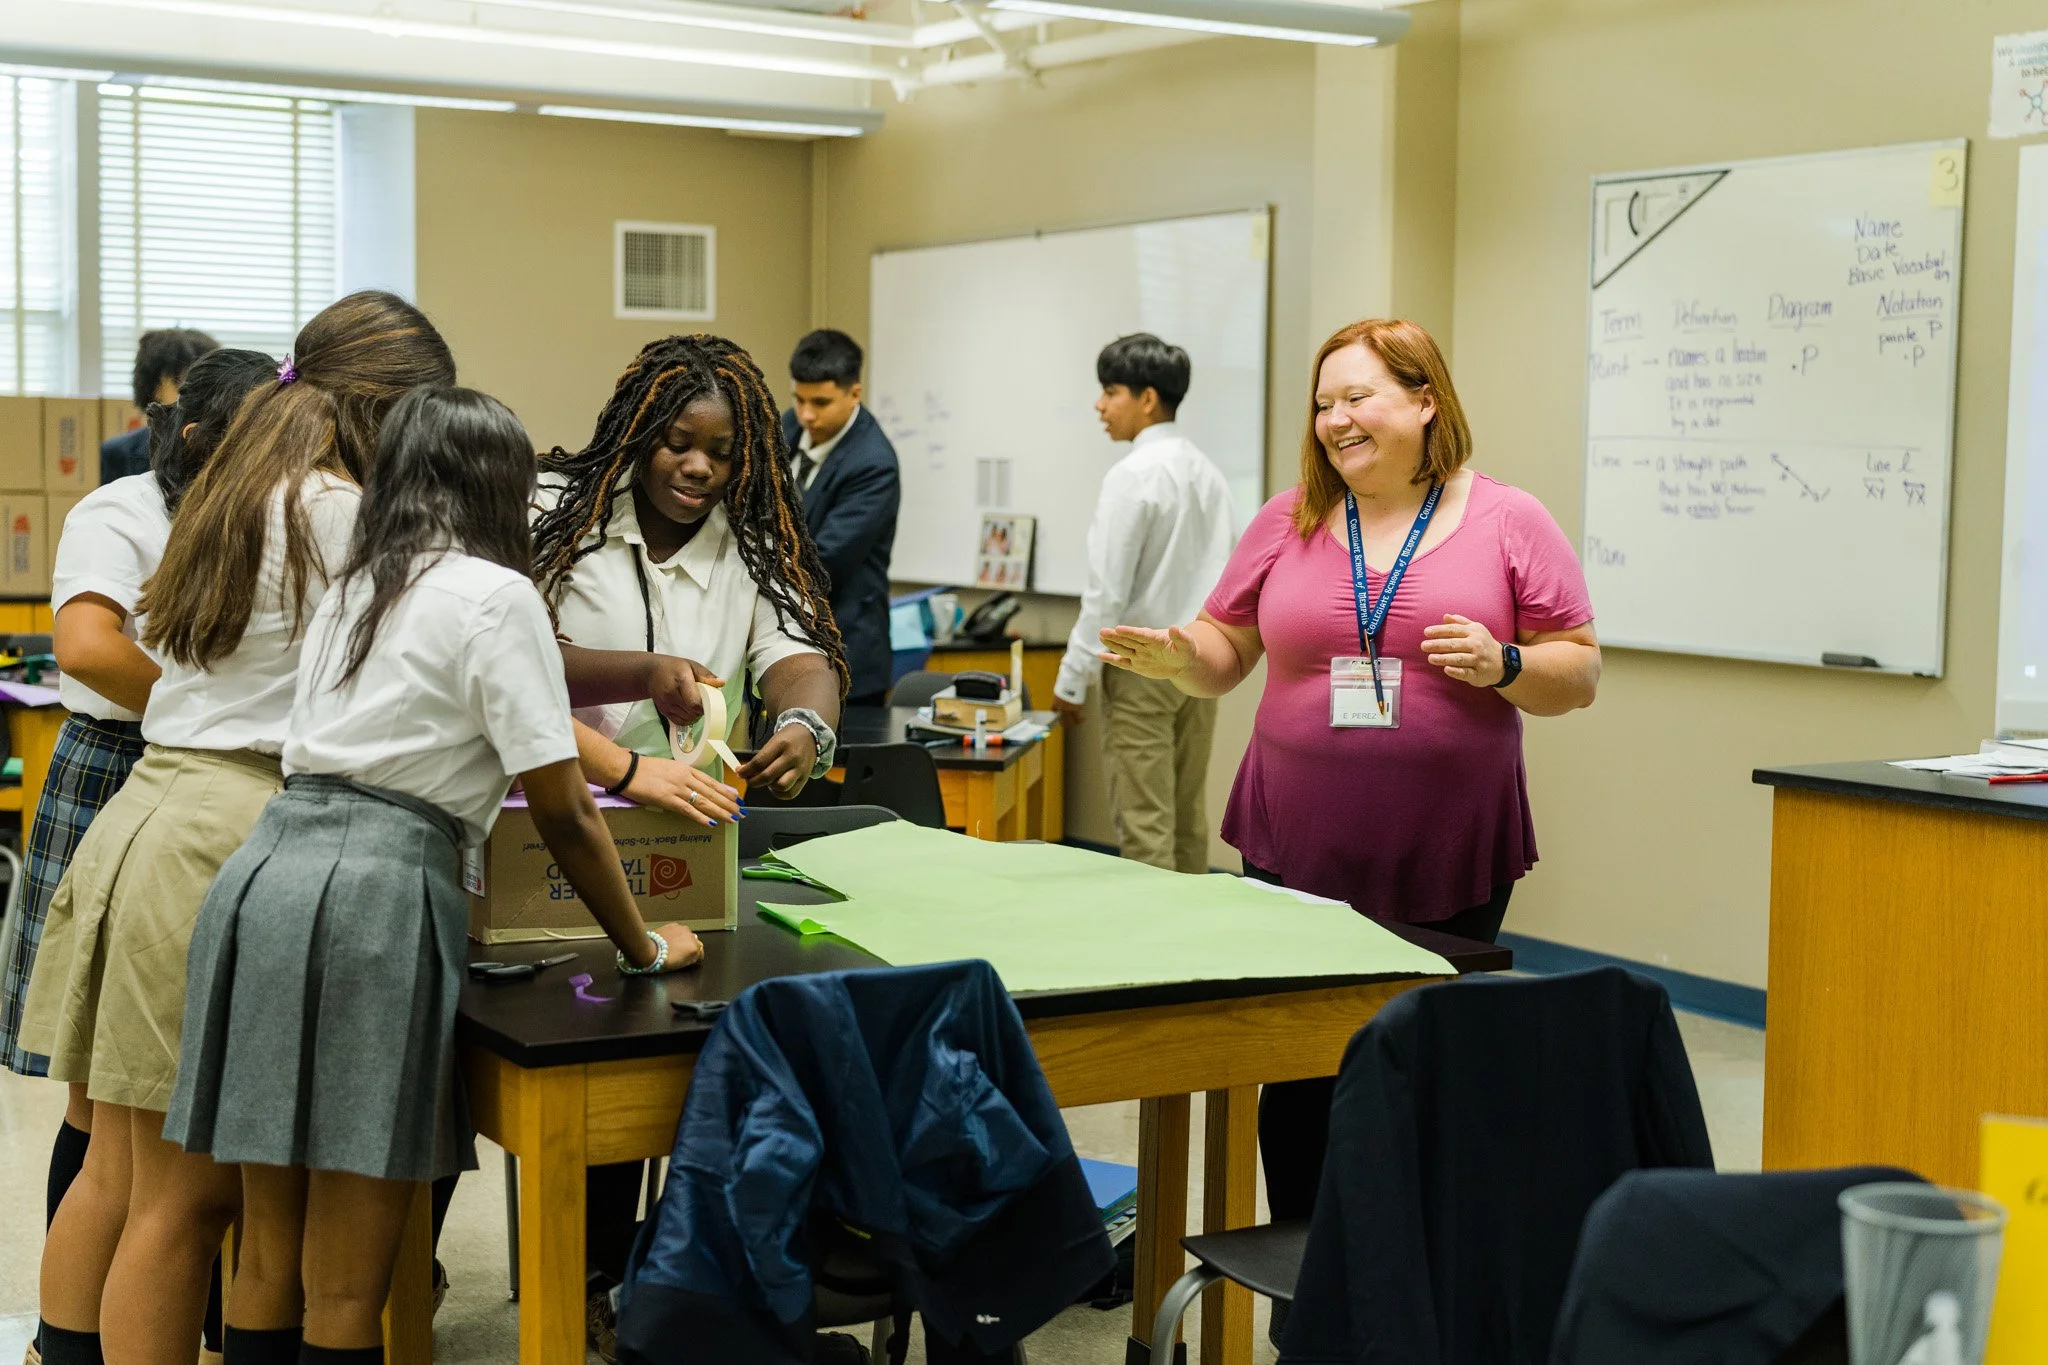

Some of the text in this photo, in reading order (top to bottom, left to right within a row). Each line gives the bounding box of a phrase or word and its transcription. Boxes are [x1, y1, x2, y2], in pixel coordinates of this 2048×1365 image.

[1938, 157, 1959, 192] 3
[1855, 213, 1903, 241] Name
[1857, 242, 1898, 265] Date
[1600, 307, 1643, 335] Term
[1768, 292, 1832, 333] Diagram
[1876, 289, 1943, 317] Notation
[680, 835, 712, 845] Making
